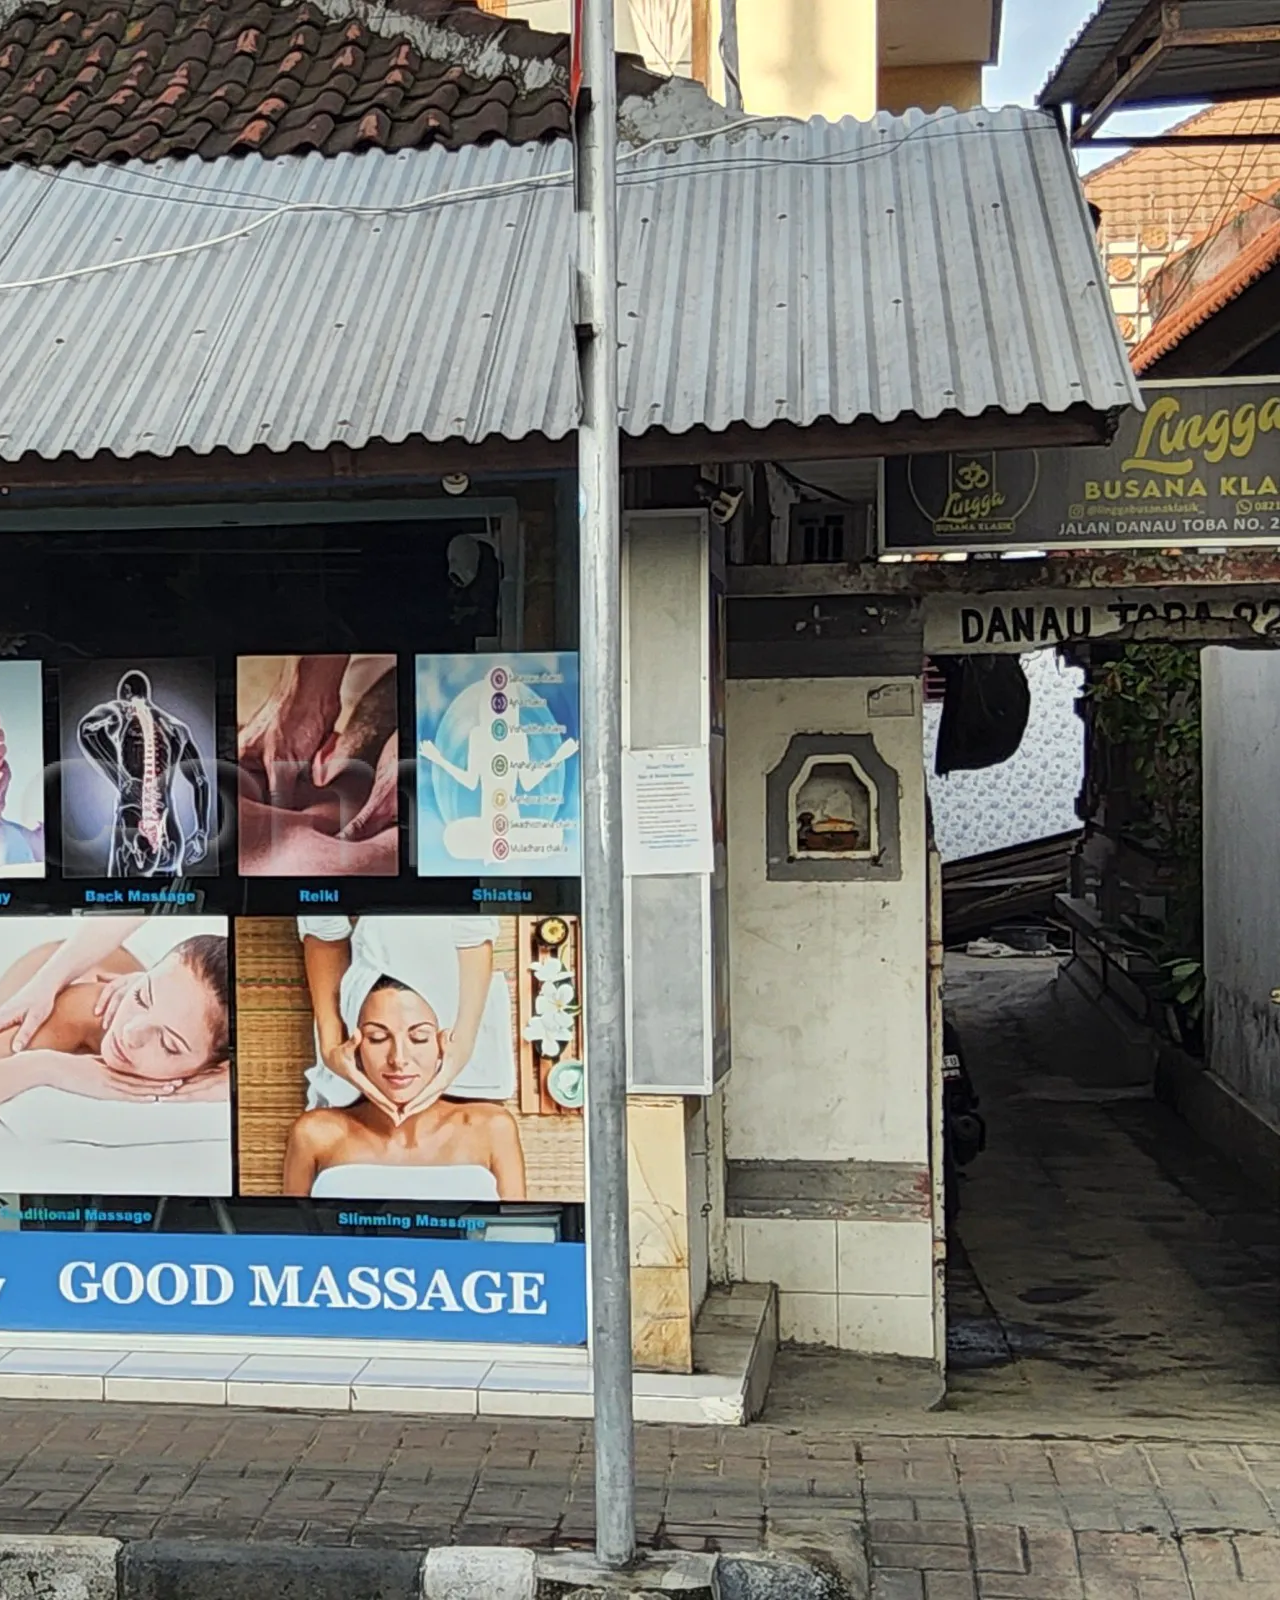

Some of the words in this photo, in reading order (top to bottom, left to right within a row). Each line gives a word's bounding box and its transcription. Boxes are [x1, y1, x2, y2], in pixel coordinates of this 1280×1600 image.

[1121, 397, 1280, 475] Lingga
[1085, 478, 1208, 499] BUSANA
[1220, 475, 1280, 496] KLA
[938, 492, 1006, 523] Lingga
[1058, 520, 1110, 536] JALAN
[1116, 518, 1177, 534] DANAU
[1182, 517, 1228, 532] TOBA
[1234, 517, 1265, 531] NO.
[961, 606, 1091, 644] DANAU
[85, 890, 123, 902] Back
[128, 890, 195, 905] Massage
[300, 889, 340, 902] Reiki
[472, 888, 532, 903] Shiatsu
[85, 1209, 152, 1224] Massage
[338, 1212, 411, 1229] Slimming
[415, 1214, 485, 1231] Massage
[59, 1261, 234, 1306] GOOD
[248, 1265, 547, 1315] MASSAGE
